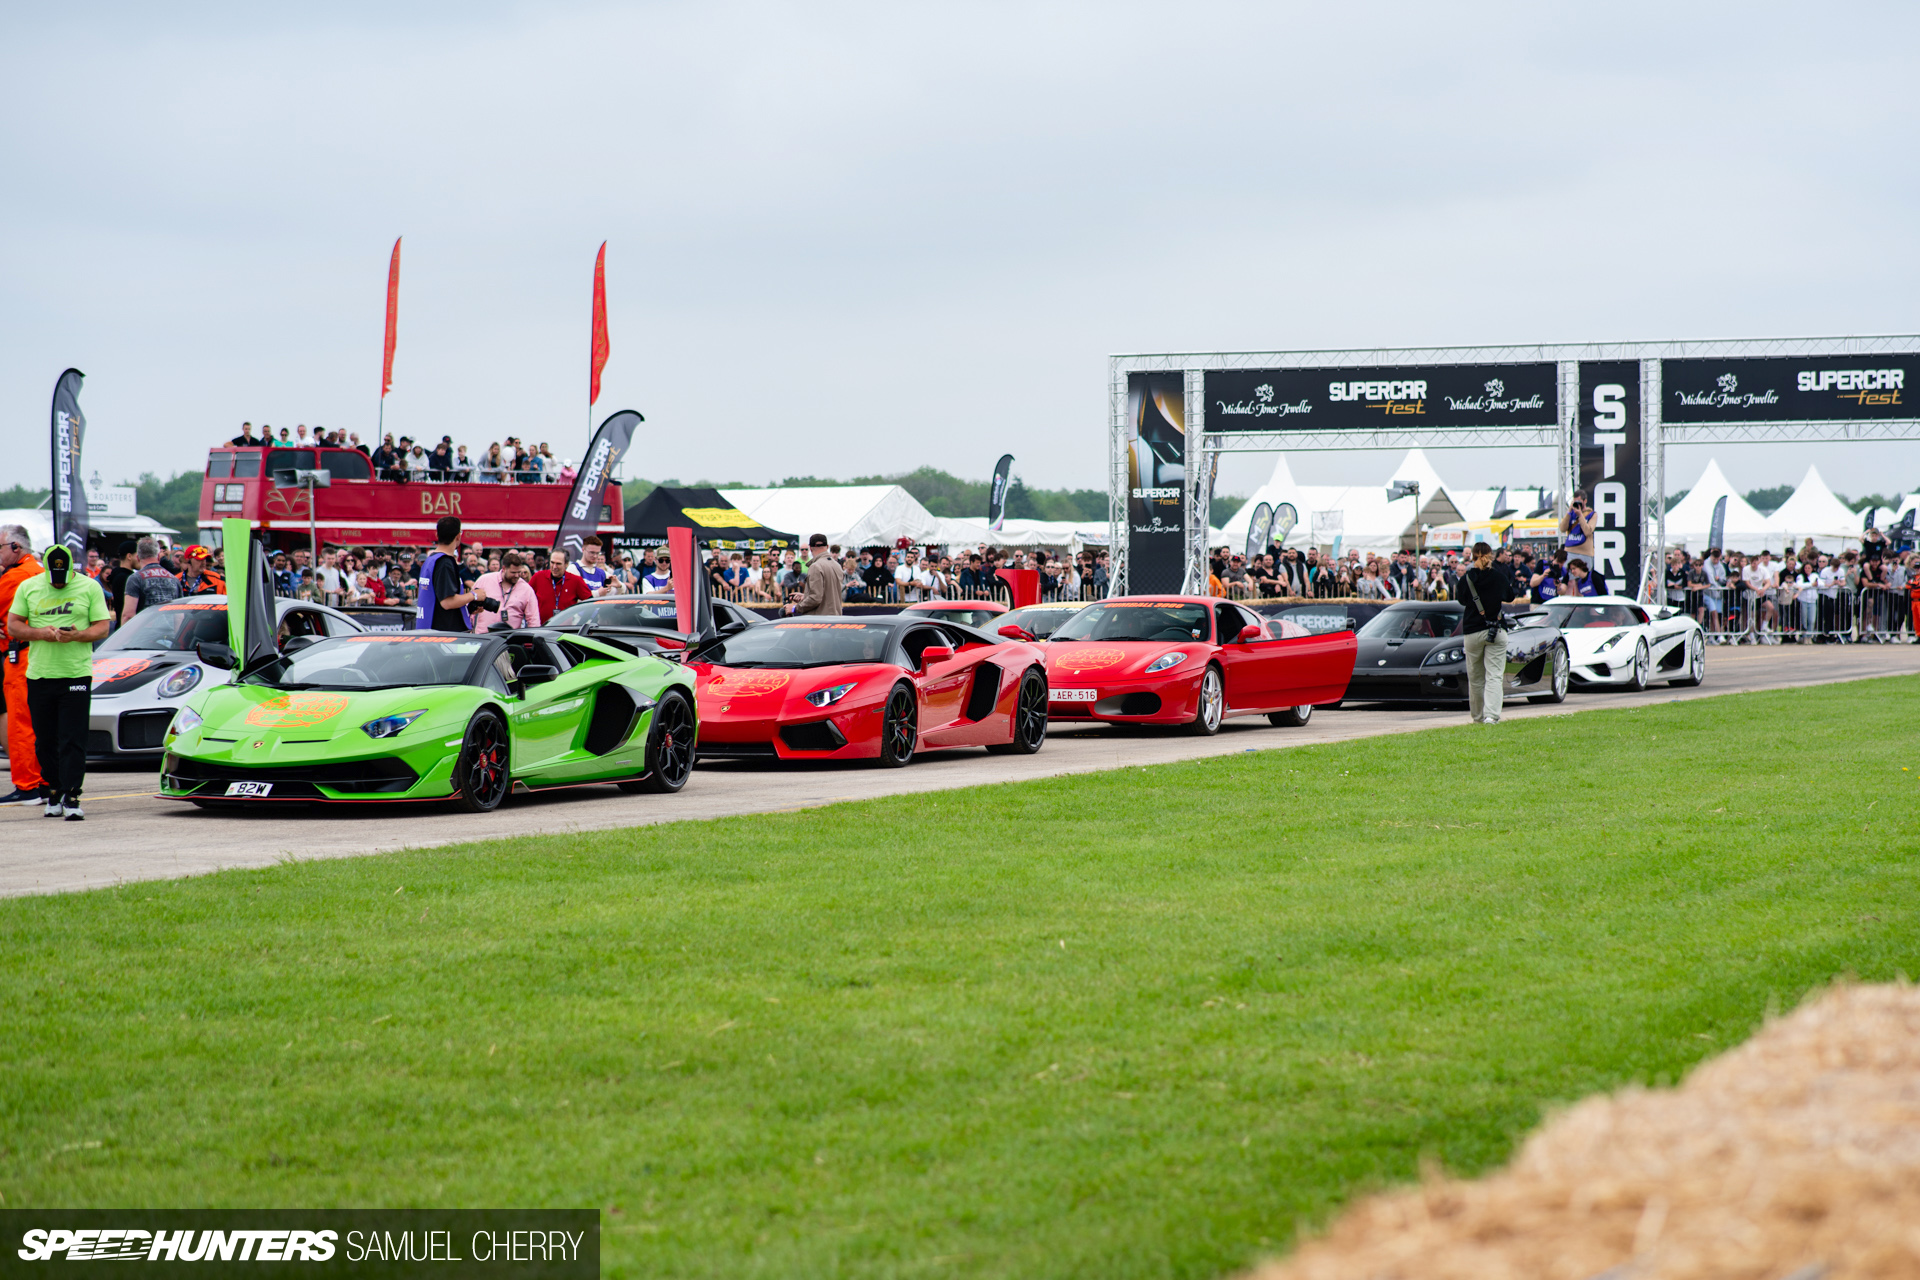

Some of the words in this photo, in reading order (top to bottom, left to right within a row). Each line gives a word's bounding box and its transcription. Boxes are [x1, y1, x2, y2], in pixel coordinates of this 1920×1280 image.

[1797, 369, 1904, 392] SUPERCAR
[1329, 380, 1428, 401] SUPERCAR
[1675, 390, 1717, 406] Michael
[1717, 392, 1743, 408] Jones
[1742, 389, 1779, 408] Jeweller
[1844, 389, 1903, 405] fest
[1216, 400, 1255, 415] Michael
[1255, 402, 1279, 417] Jones
[1279, 399, 1313, 417] Jeweller
[1373, 400, 1427, 415] fest
[1444, 395, 1485, 411] Michael
[1484, 398, 1509, 413] Jones
[1509, 394, 1545, 413] Jeweller
[56, 410, 72, 513] SUPERCAR
[600, 446, 621, 485] fest
[571, 438, 612, 520] SUPERCAR
[94, 493, 133, 503] ROASTERS
[1132, 487, 1181, 498] SUPERCAR
[1152, 497, 1180, 505] fest
[421, 491, 462, 515] BAR
[237, 782, 268, 795] 82W
